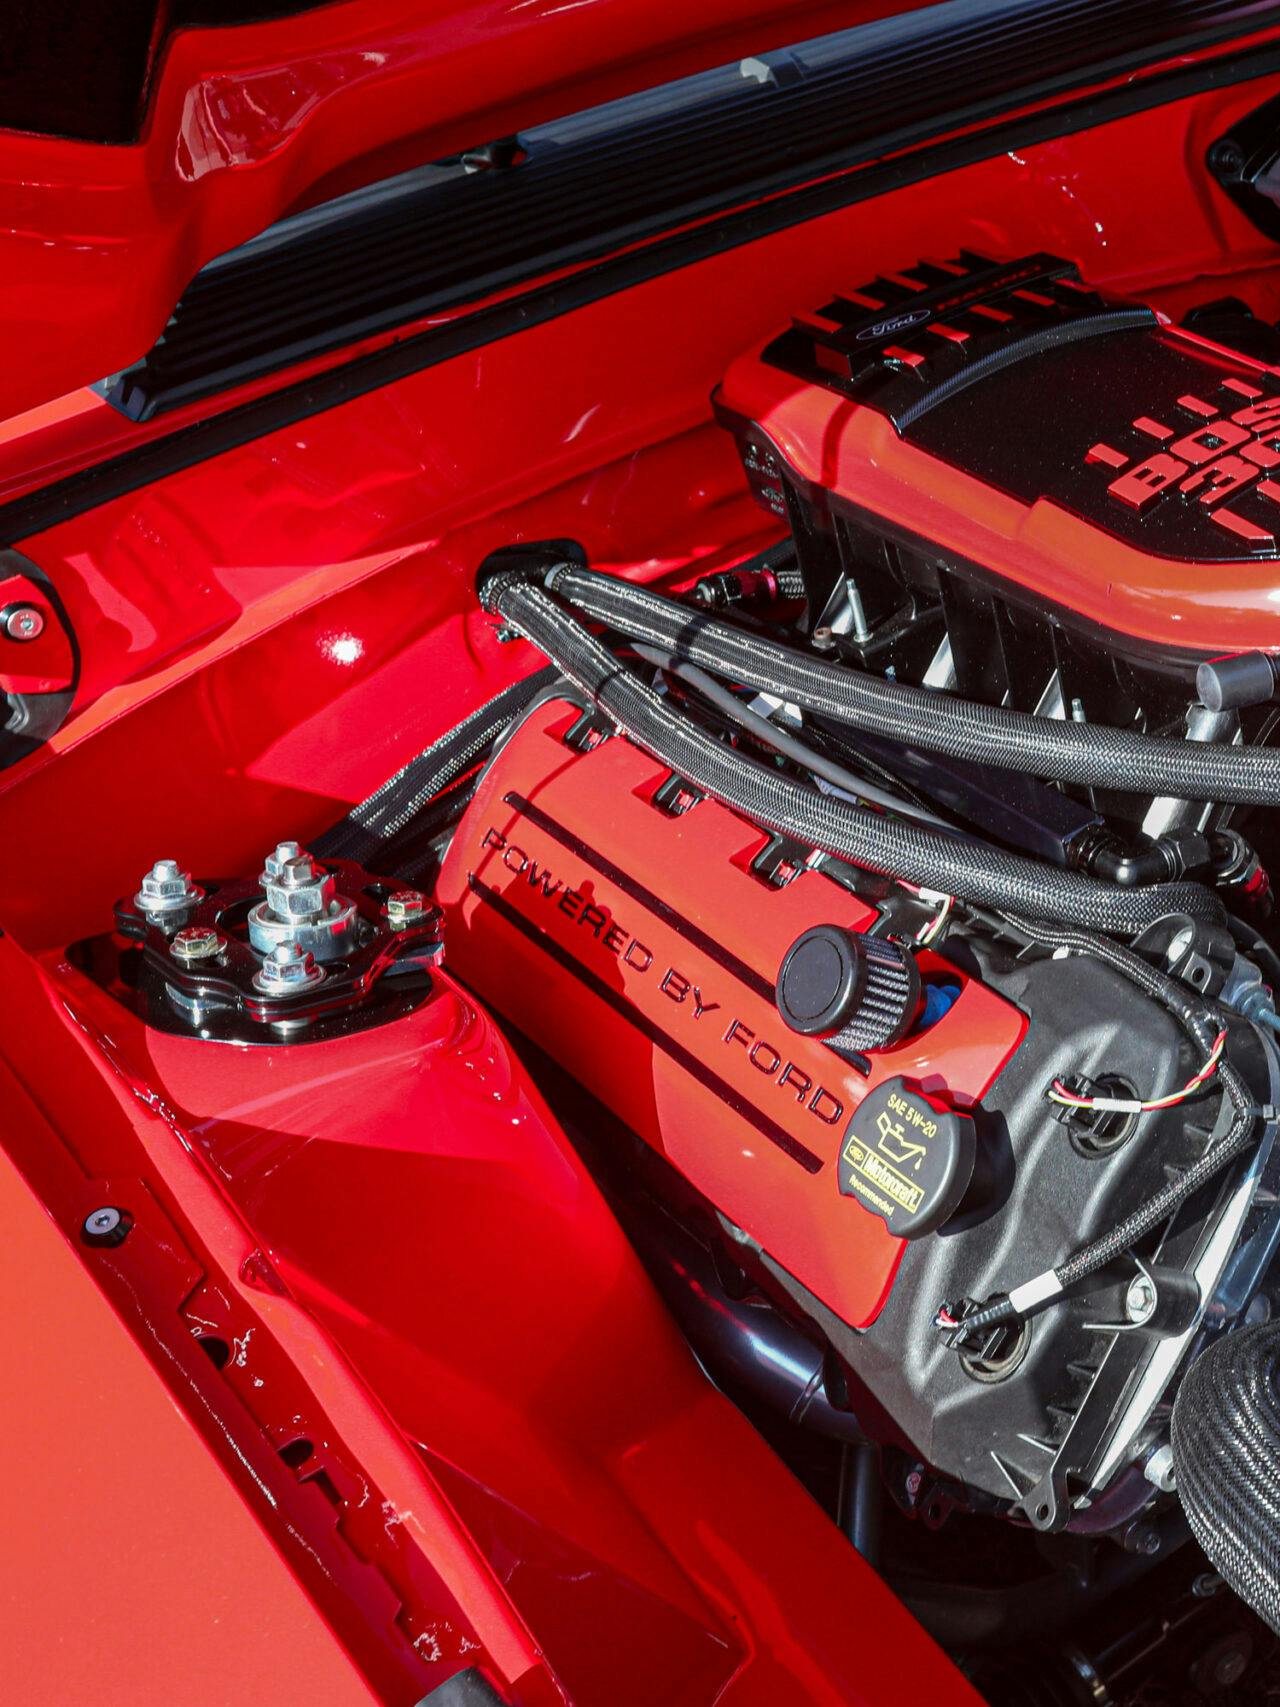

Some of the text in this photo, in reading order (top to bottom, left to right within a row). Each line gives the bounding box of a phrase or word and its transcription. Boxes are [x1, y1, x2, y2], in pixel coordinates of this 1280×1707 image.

[872, 314, 917, 336] Ford
[480, 828, 844, 1125] POWERED BY FORD
[887, 1093, 908, 1116] SAE
[849, 1174, 895, 1217] Recommended
[863, 1154, 918, 1208] Motorcraft
